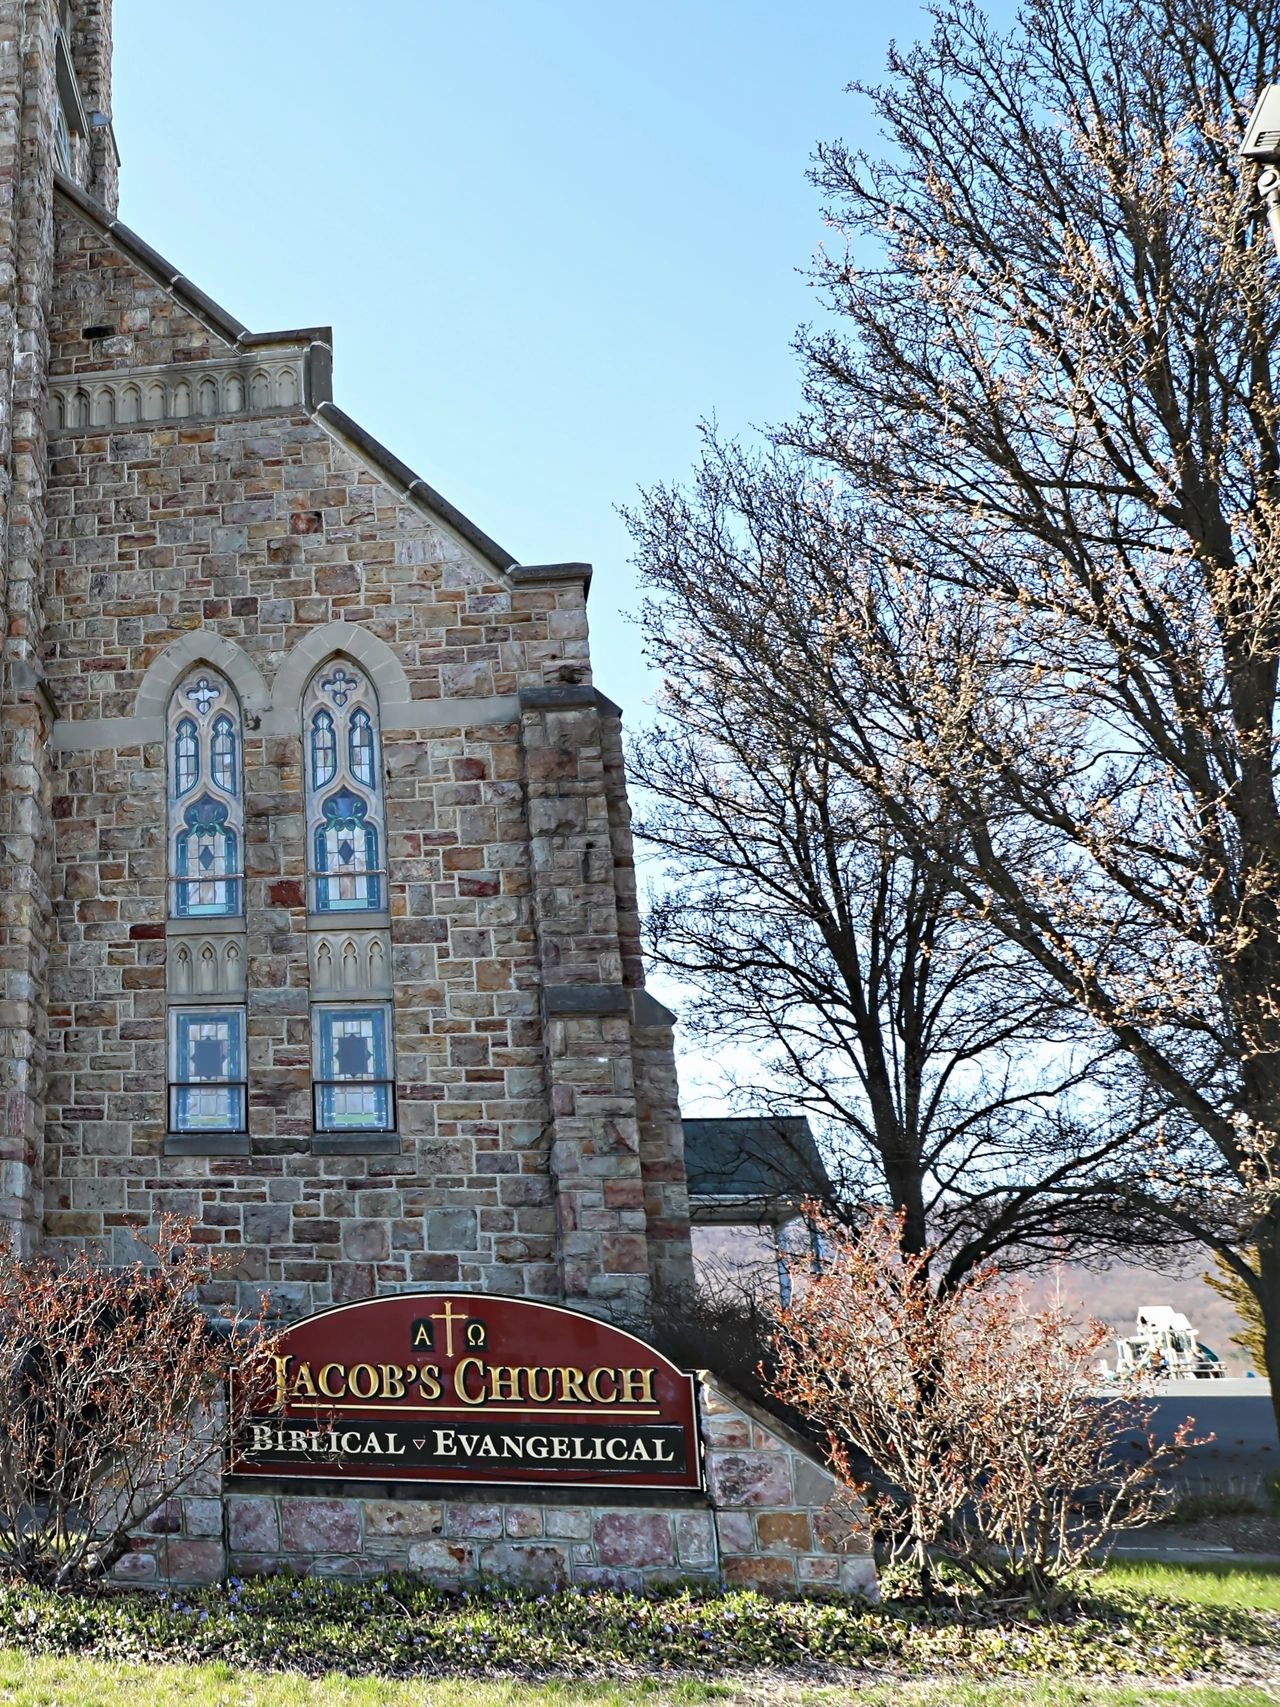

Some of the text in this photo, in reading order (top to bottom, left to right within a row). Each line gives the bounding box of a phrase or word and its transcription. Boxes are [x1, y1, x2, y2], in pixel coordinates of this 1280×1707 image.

[467, 1324, 486, 1346] Ω
[268, 1355, 657, 1413] JACOB'S CHURCH
[250, 1425, 675, 1462] BIBLICAL EVANGELICAL
